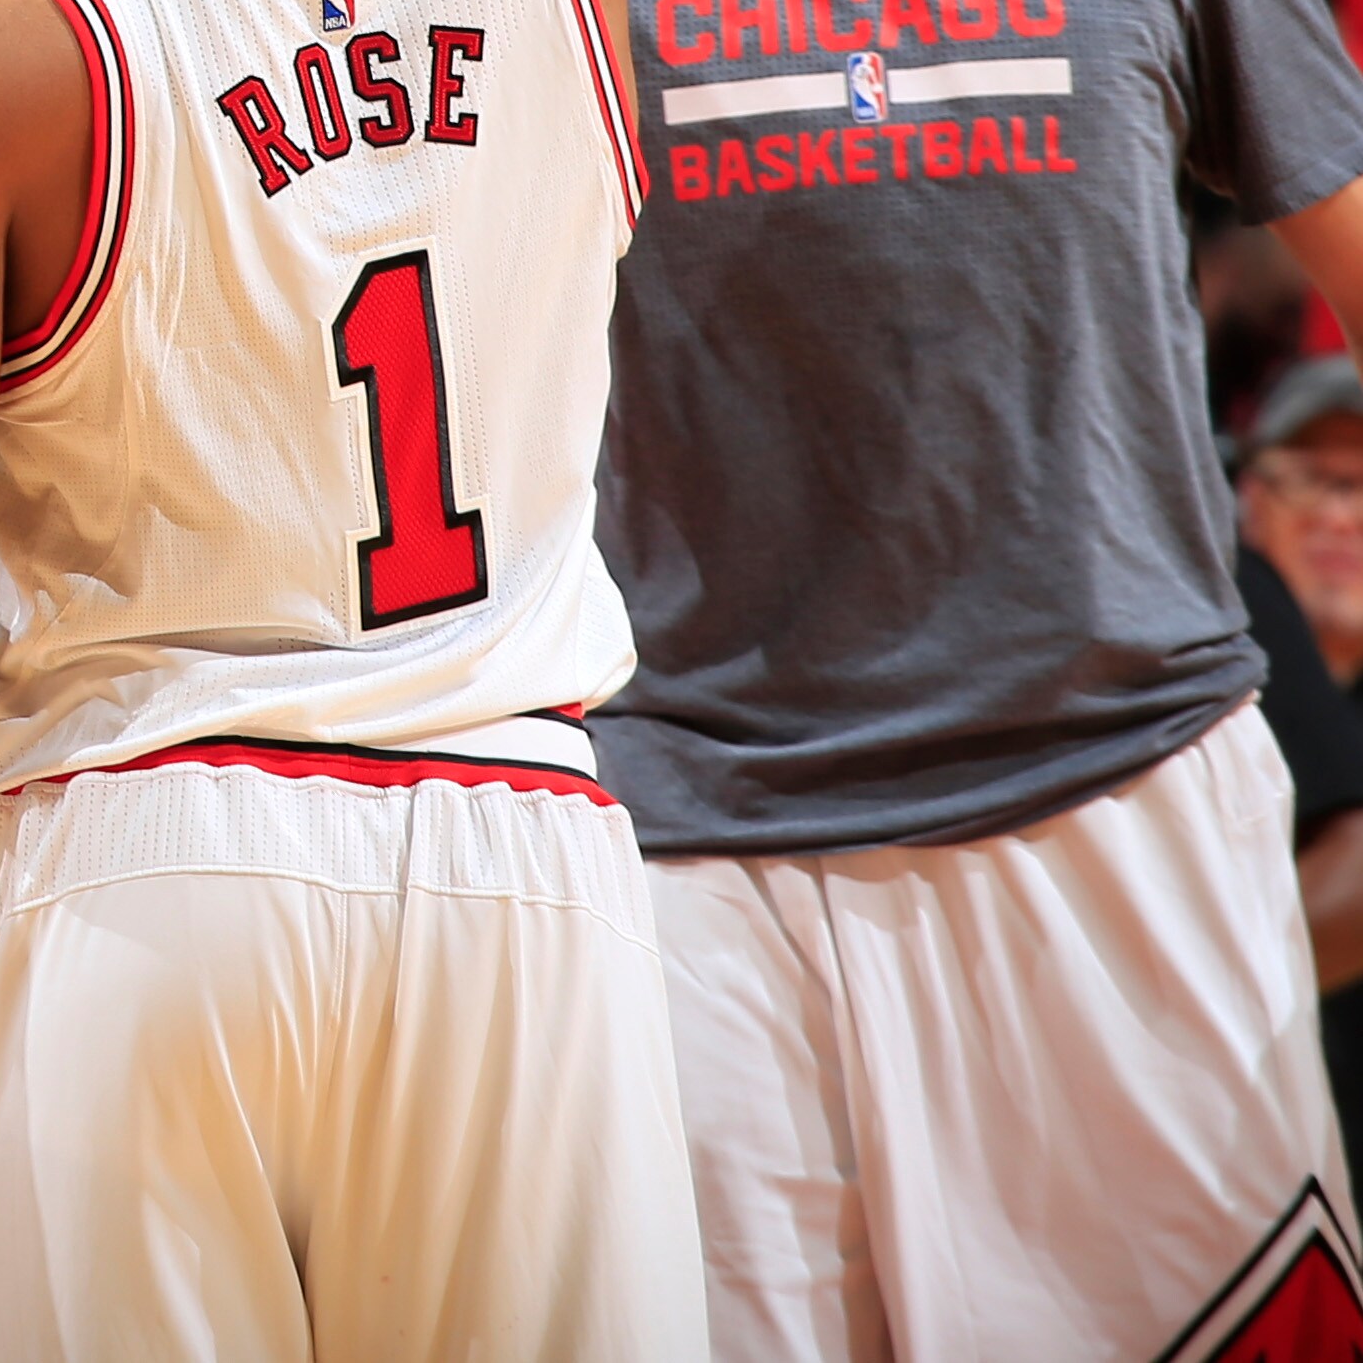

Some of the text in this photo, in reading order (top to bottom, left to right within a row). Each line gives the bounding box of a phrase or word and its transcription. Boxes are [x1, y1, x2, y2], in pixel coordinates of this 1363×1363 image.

[325, 17, 347, 30] NBA
[215, 24, 485, 198] ROSE
[669, 115, 1078, 202] BASKETBALL
[331, 249, 488, 631] 1
